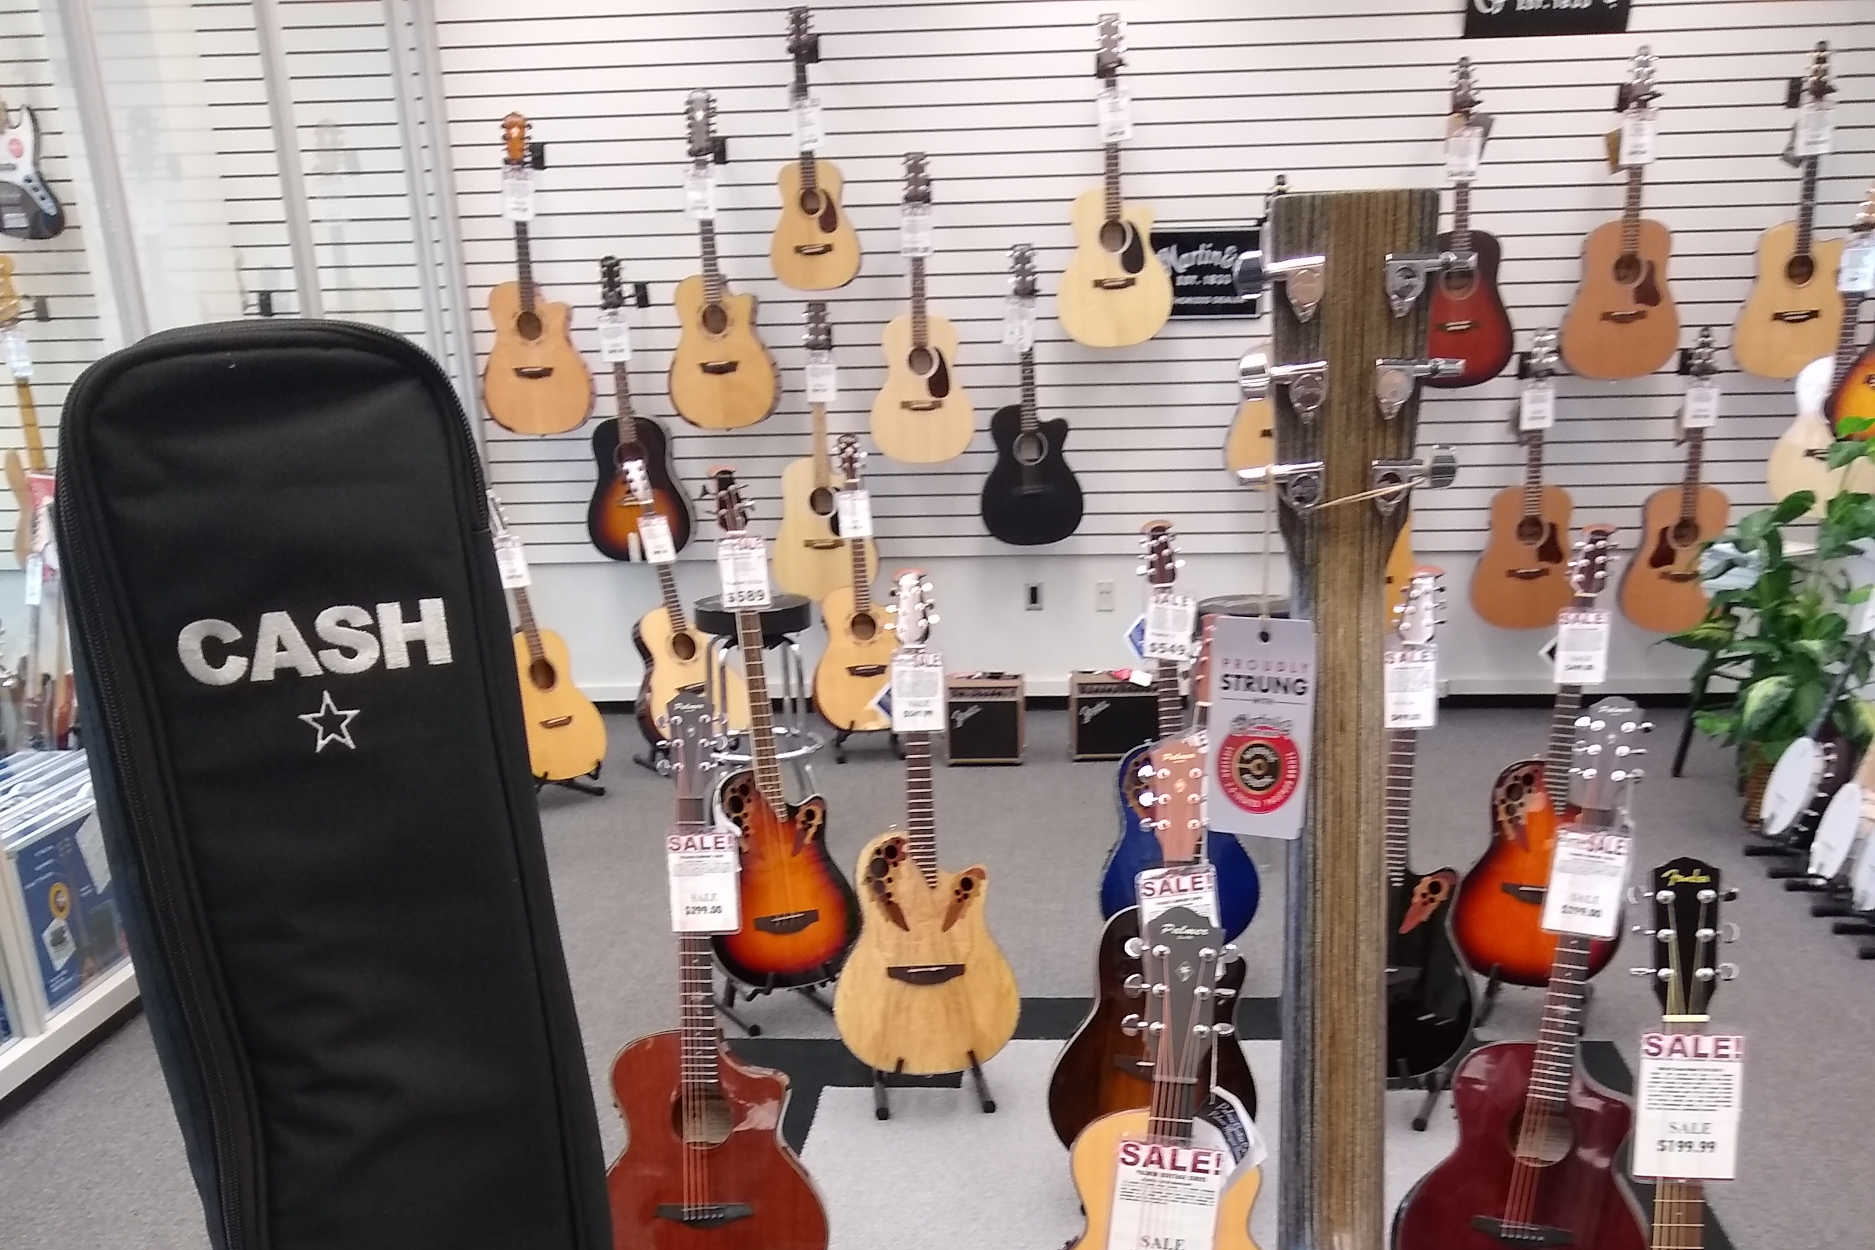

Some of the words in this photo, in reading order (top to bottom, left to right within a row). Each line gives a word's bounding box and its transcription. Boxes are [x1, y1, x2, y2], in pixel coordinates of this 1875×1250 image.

[177, 597, 454, 686] CASH
[1222, 674, 1308, 696] STRUNG
[1644, 1034, 1743, 1059] SALE!
[1669, 1121, 1713, 1135] SALE
[1120, 1143, 1223, 1175] SALE!
